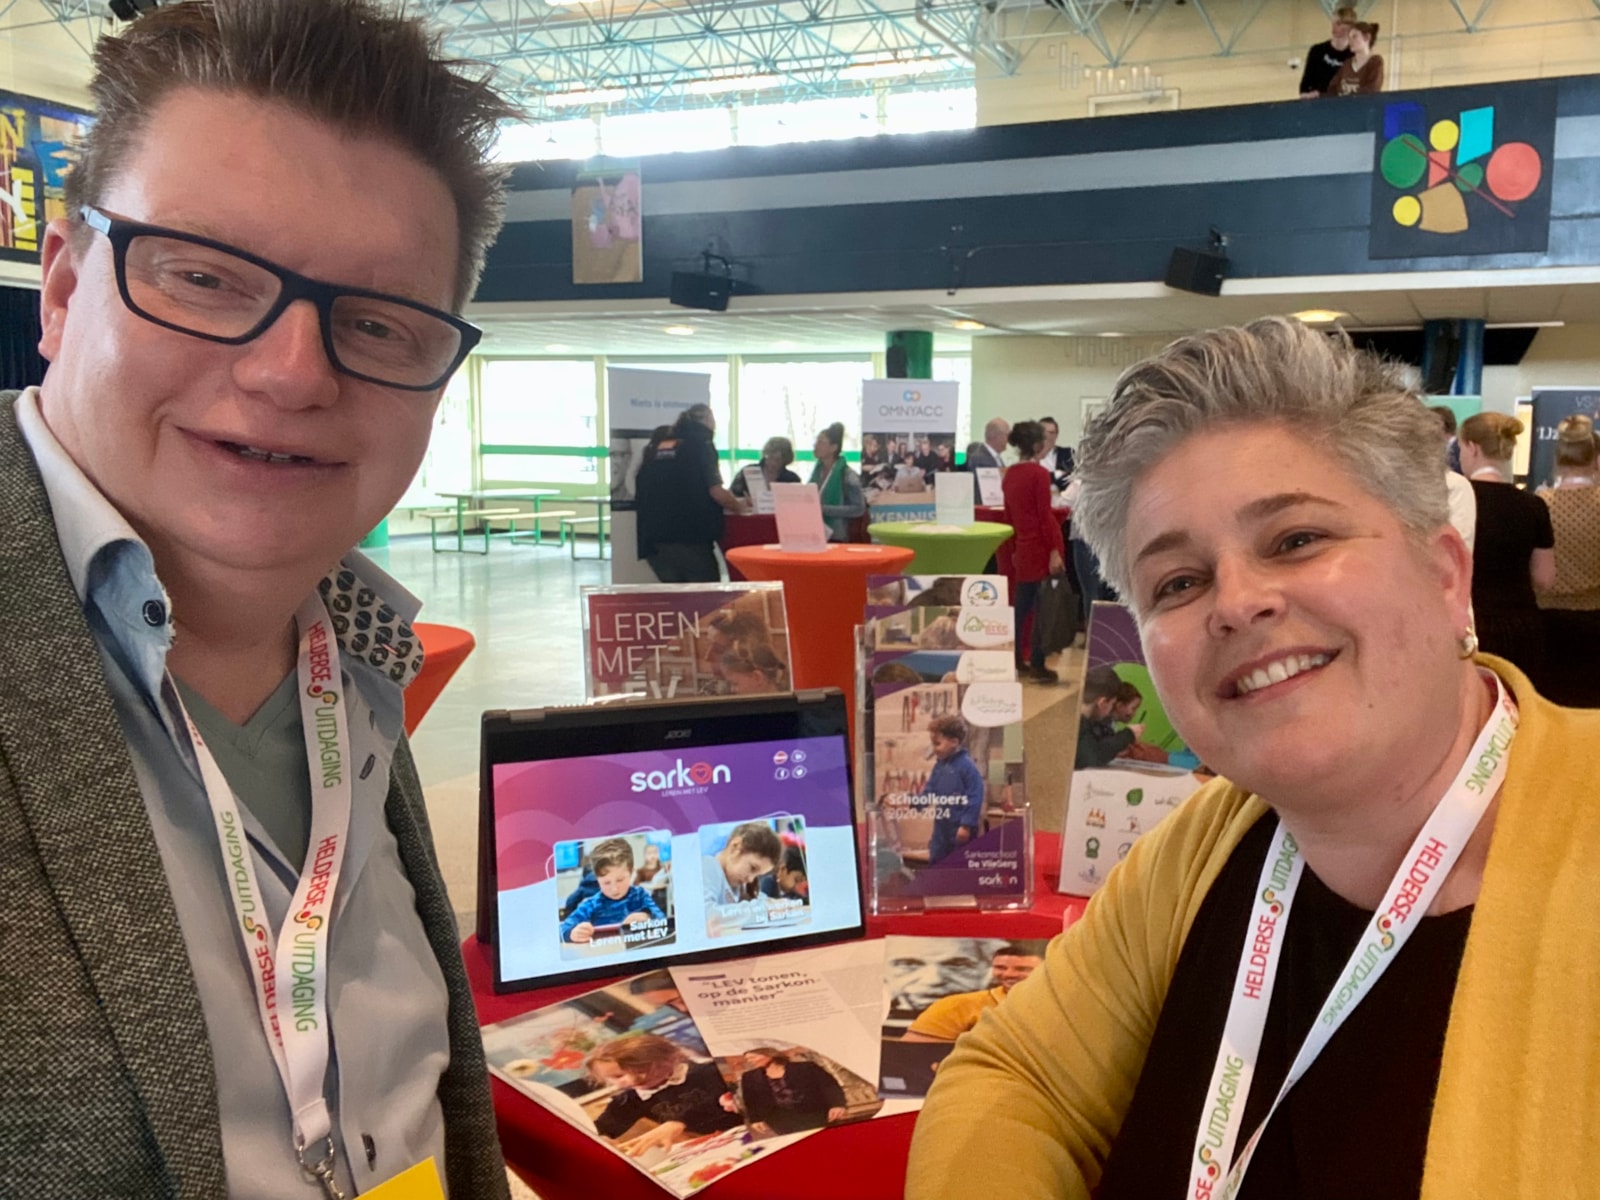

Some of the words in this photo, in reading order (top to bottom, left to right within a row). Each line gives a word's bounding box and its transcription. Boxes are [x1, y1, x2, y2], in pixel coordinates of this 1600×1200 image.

[878, 404, 944, 417] OMNYACC
[594, 610, 702, 643] LEREN
[308, 621, 331, 683] HELDERSE
[597, 645, 669, 677] MET
[315, 704, 342, 789] UITDAGING
[1465, 716, 1513, 795] UITDAGING
[631, 758, 731, 792] sarkon
[661, 789, 682, 797] LEREN
[696, 786, 709, 794] LEV
[888, 792, 968, 806] Schoolkoers
[888, 808, 951, 820] 2020-2024
[220, 810, 255, 913] UITDAGING
[304, 834, 338, 909] HELDERSE
[968, 860, 980, 868] De
[1270, 831, 1299, 892] UITDAG
[1388, 837, 1447, 925] HELDERSE
[589, 934, 620, 948] Leren
[623, 931, 646, 944] met
[646, 927, 669, 941] LEV
[629, 916, 668, 931] Sarkon
[1243, 915, 1277, 1000] HELDERSE
[292, 933, 318, 1032] UITDAGING
[697, 989, 729, 1000] op
[731, 986, 749, 996] de
[1322, 942, 1385, 1027] UITDAGING
[1204, 1055, 1244, 1148] UITDAGING
